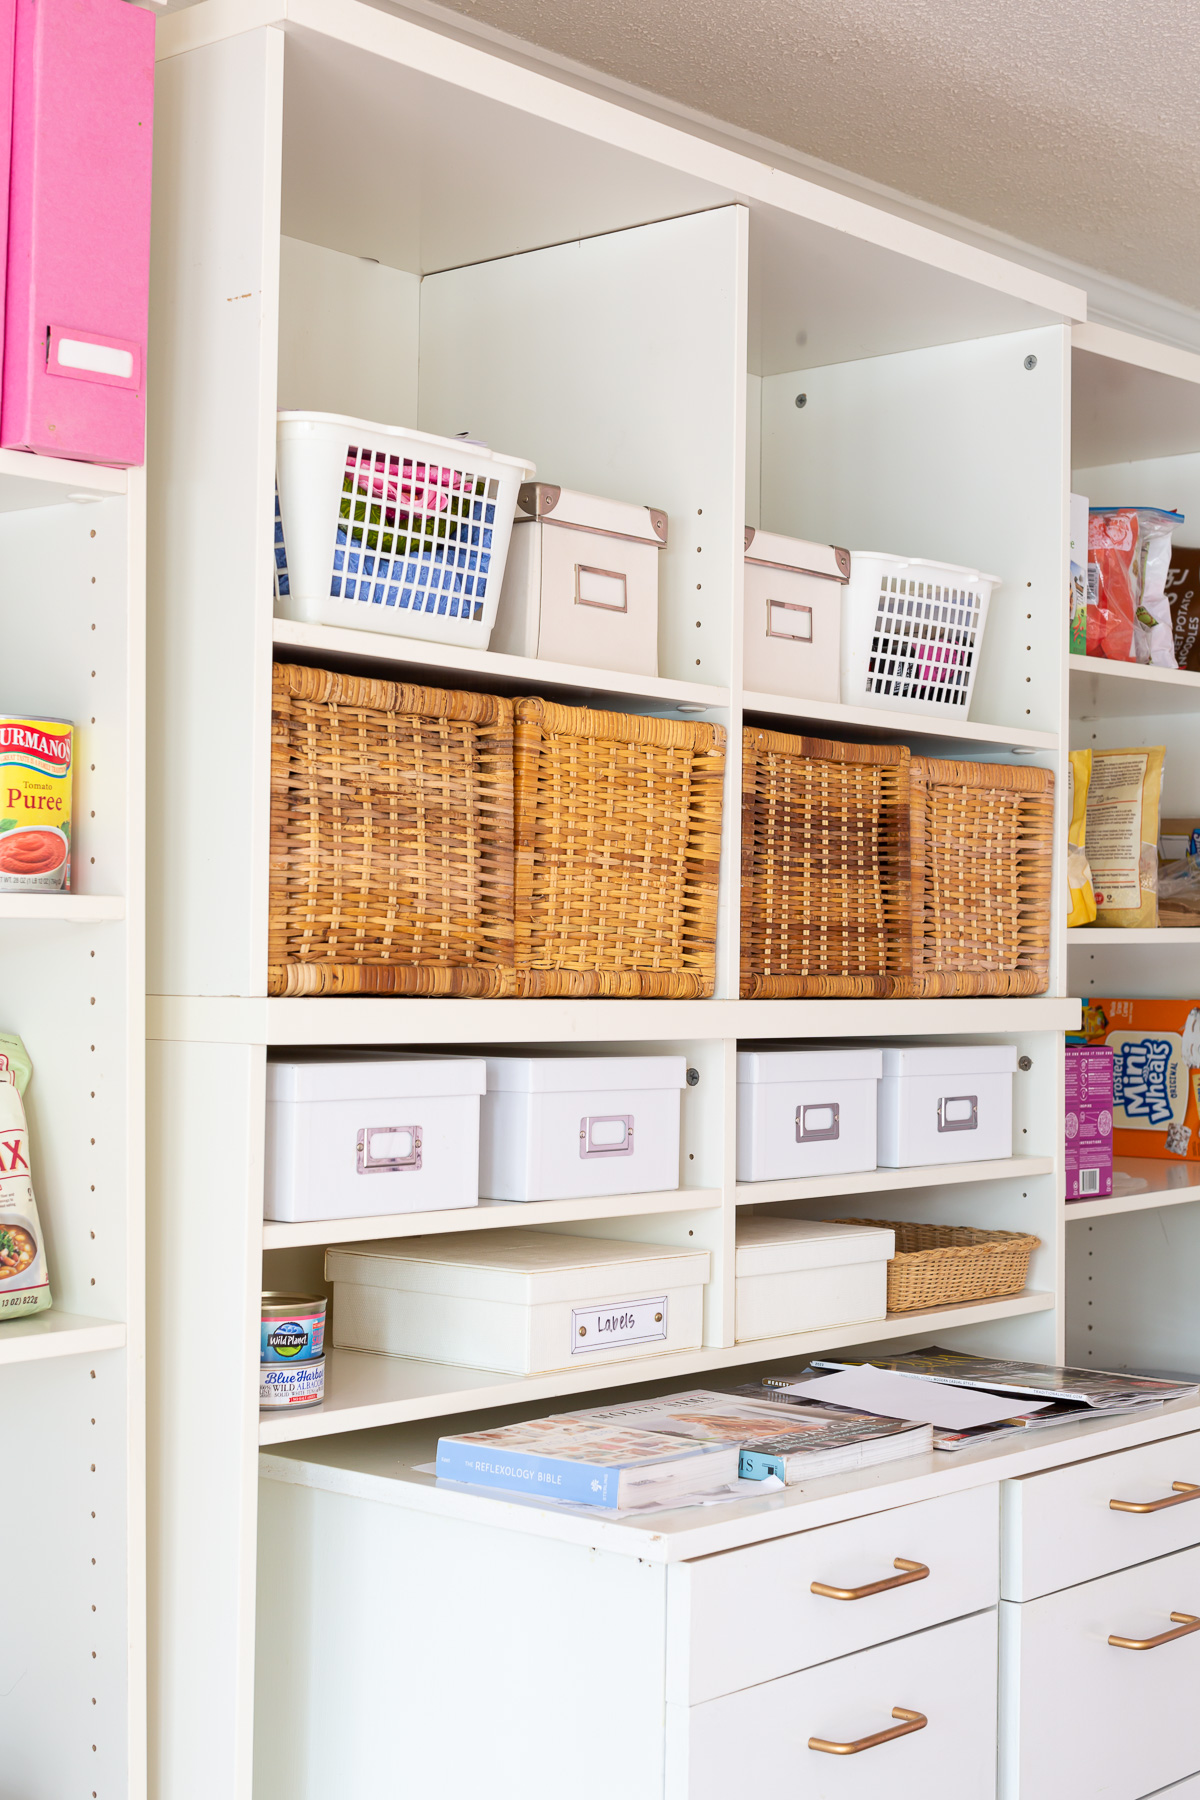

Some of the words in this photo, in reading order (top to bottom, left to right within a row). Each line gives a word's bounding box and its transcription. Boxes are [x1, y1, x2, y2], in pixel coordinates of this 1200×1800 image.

[1176, 590, 1194, 633] POTATO
[1179, 616, 1199, 666] NOODLES
[23, 780, 53, 791] Tomato
[6, 788, 63, 811] Puree
[1113, 1057, 1124, 1107] Frosted
[1124, 1045, 1149, 1115] Mini
[1146, 1042, 1171, 1122] Wheats
[1170, 1062, 1179, 1099] ORIGINAL
[597, 1312, 636, 1333] Labels
[270, 1335, 287, 1345] Wild
[287, 1334, 307, 1346] Planet
[265, 1372, 296, 1384] Blue
[272, 1384, 295, 1392] WILD
[1033, 1389, 1083, 1400] TRADITIONALHOME.COM
[592, 1405, 661, 1421] MOLLY
[664, 1396, 715, 1408] SIMS
[465, 1460, 474, 1469] THE
[475, 1461, 535, 1480] REFLEXOLOGY
[537, 1471, 562, 1486] BIBLE
